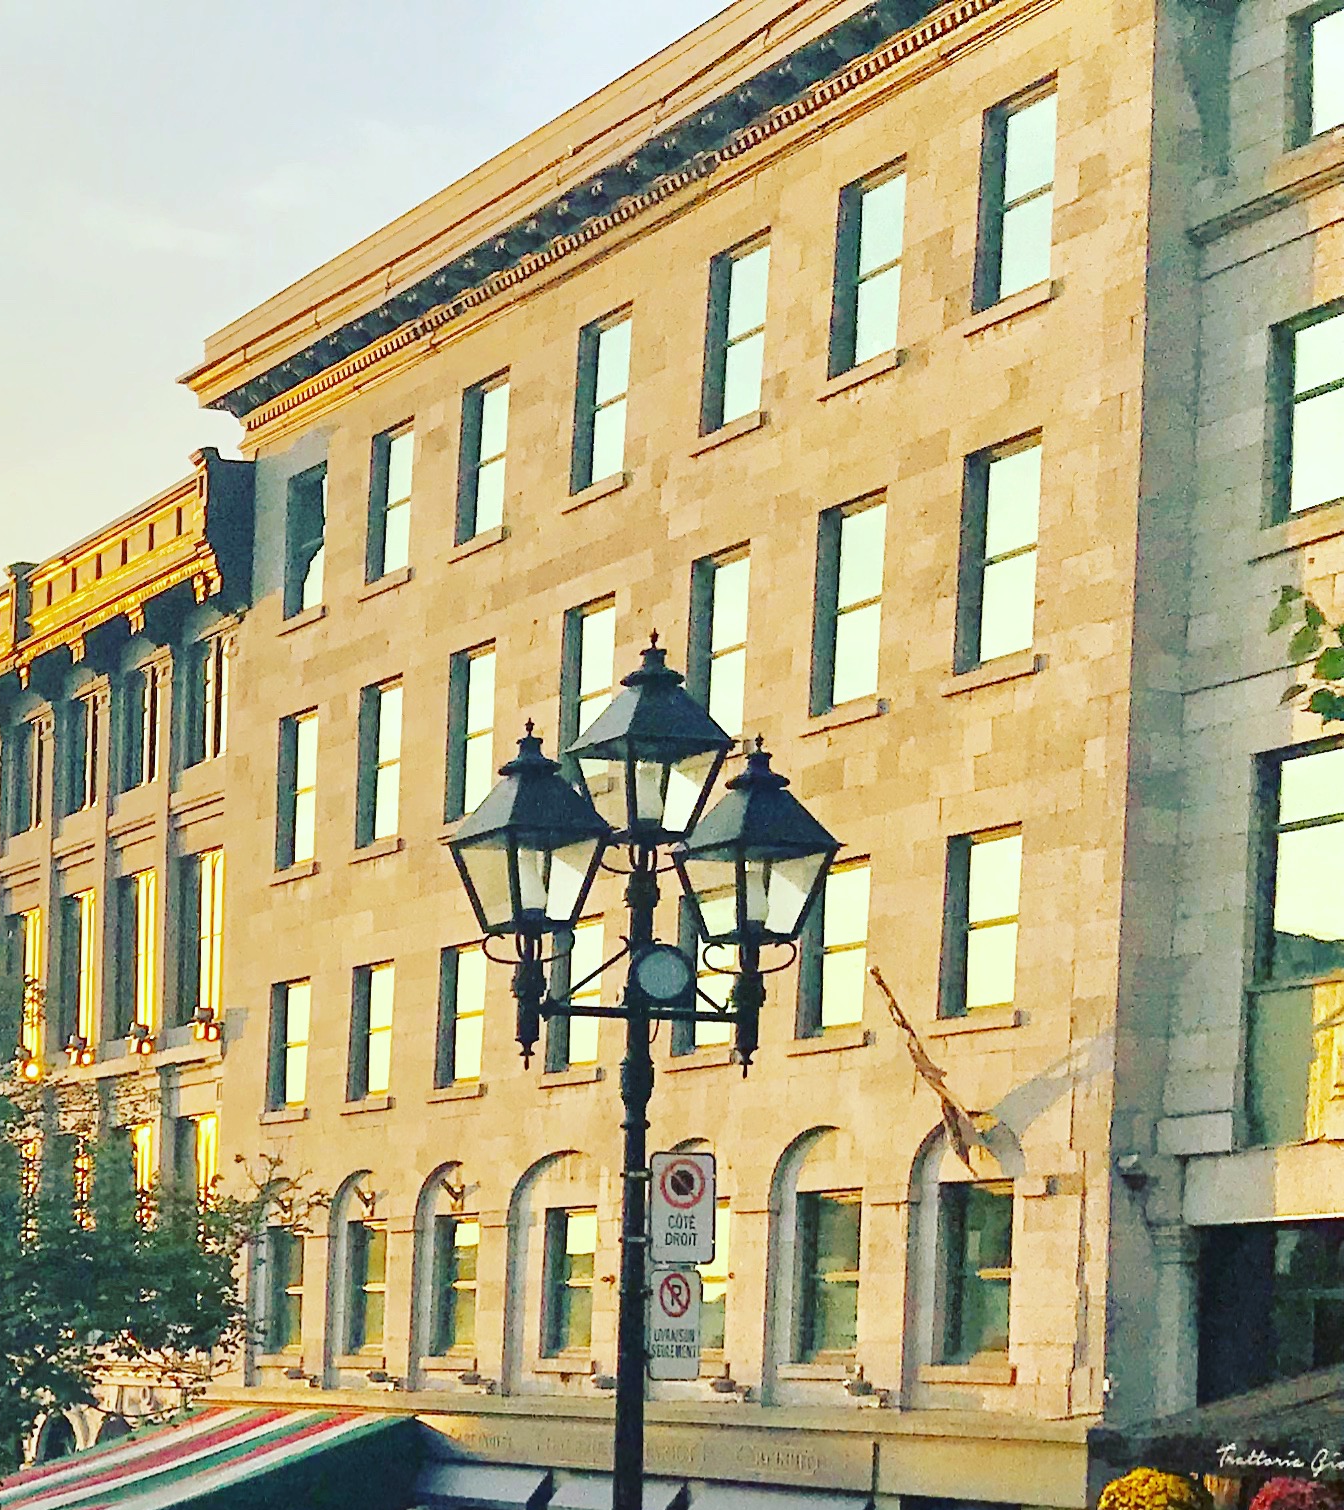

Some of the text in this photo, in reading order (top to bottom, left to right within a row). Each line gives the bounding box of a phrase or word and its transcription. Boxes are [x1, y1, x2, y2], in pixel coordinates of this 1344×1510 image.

[668, 1212, 696, 1230] CÔTÉ
[665, 1232, 698, 1246] DROIT
[1216, 1442, 1305, 1468] Trattoria
